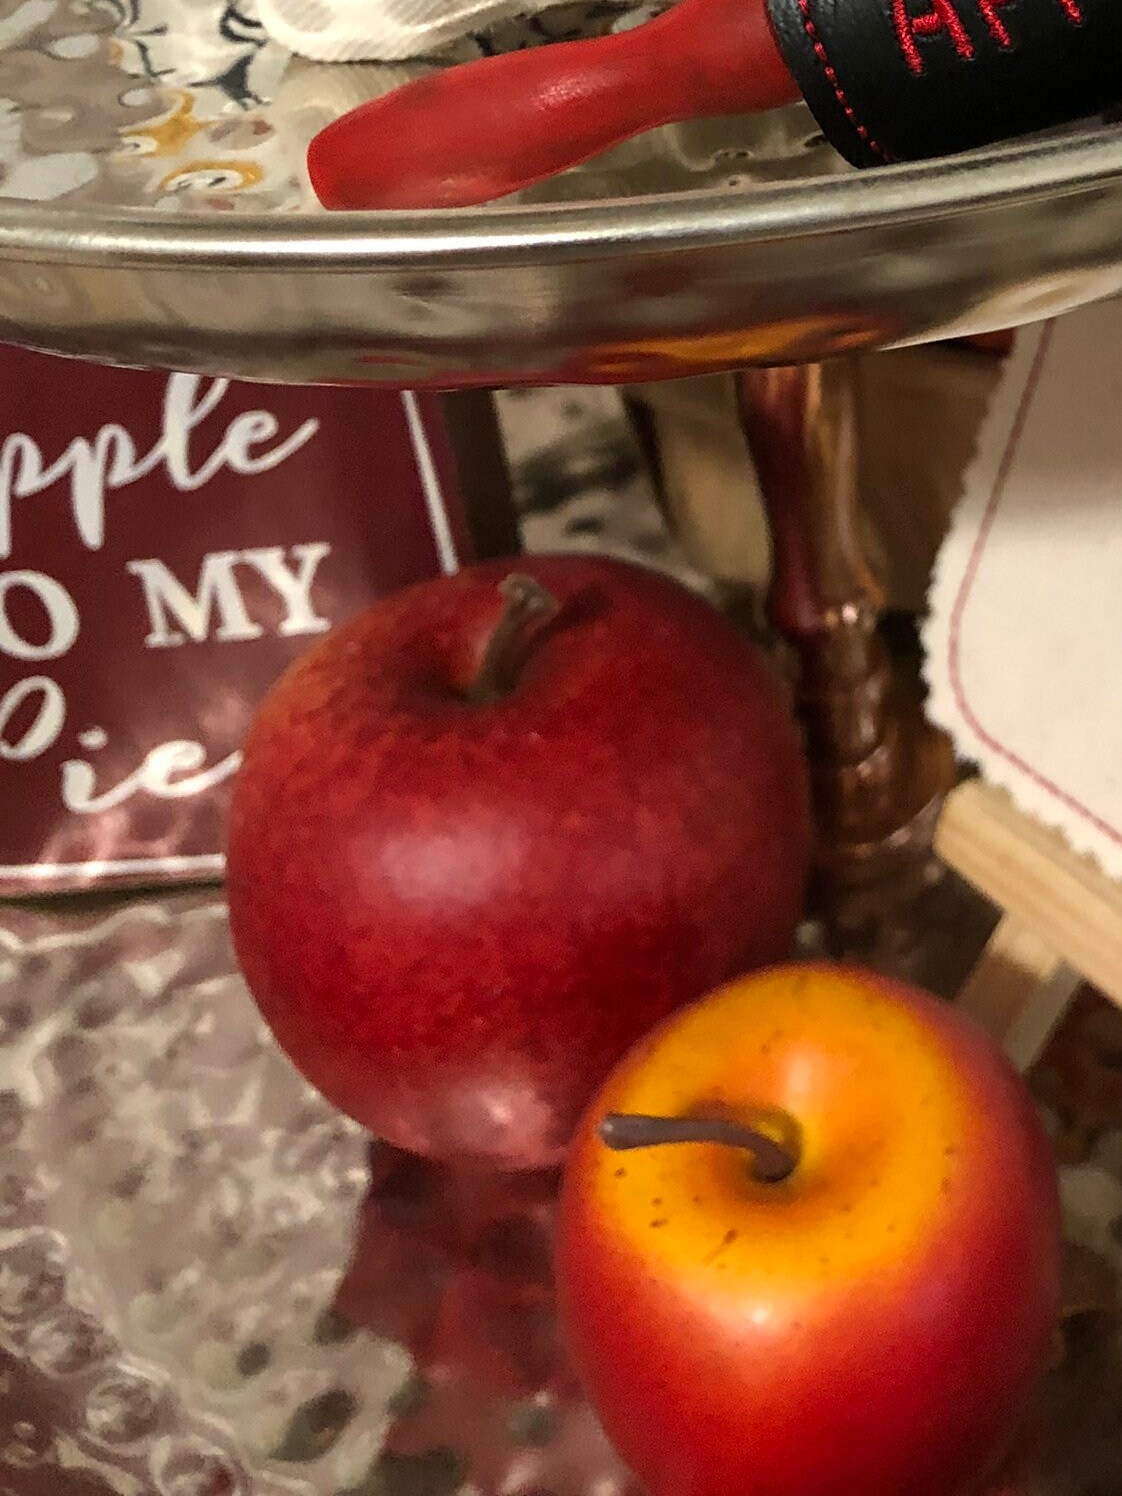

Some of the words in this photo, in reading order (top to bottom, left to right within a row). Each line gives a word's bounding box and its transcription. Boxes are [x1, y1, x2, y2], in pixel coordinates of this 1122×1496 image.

[0, 372, 320, 558] pple
[0, 569, 80, 661] O
[126, 541, 332, 649] MY
